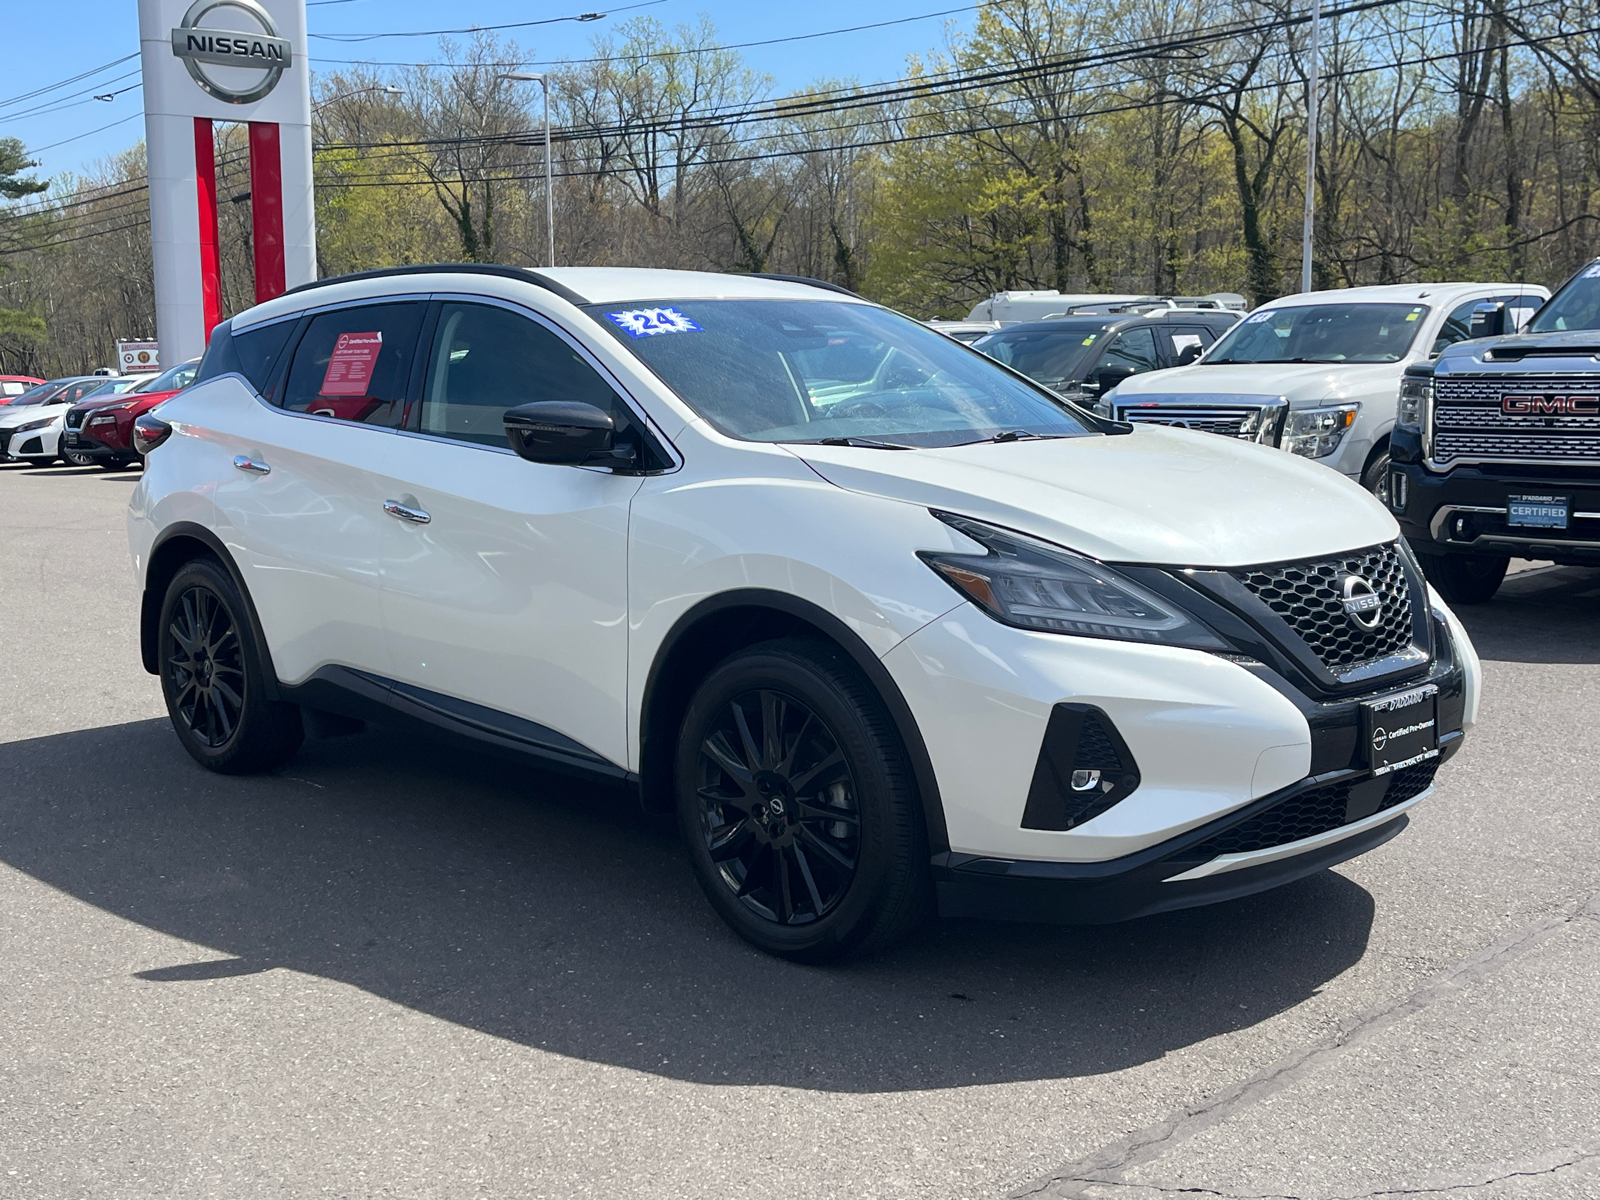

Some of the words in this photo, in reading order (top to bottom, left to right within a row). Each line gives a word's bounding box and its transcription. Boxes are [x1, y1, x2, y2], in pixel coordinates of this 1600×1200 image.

[186, 34, 283, 61] NISSAN
[632, 312, 677, 330] 24
[1502, 396, 1599, 414] GMC
[1511, 506, 1566, 517] CERTIFIED
[1389, 691, 1424, 711] D'ADDARIO
[1388, 726, 1410, 739] Certified
[1409, 718, 1435, 733] Pre-Owned
